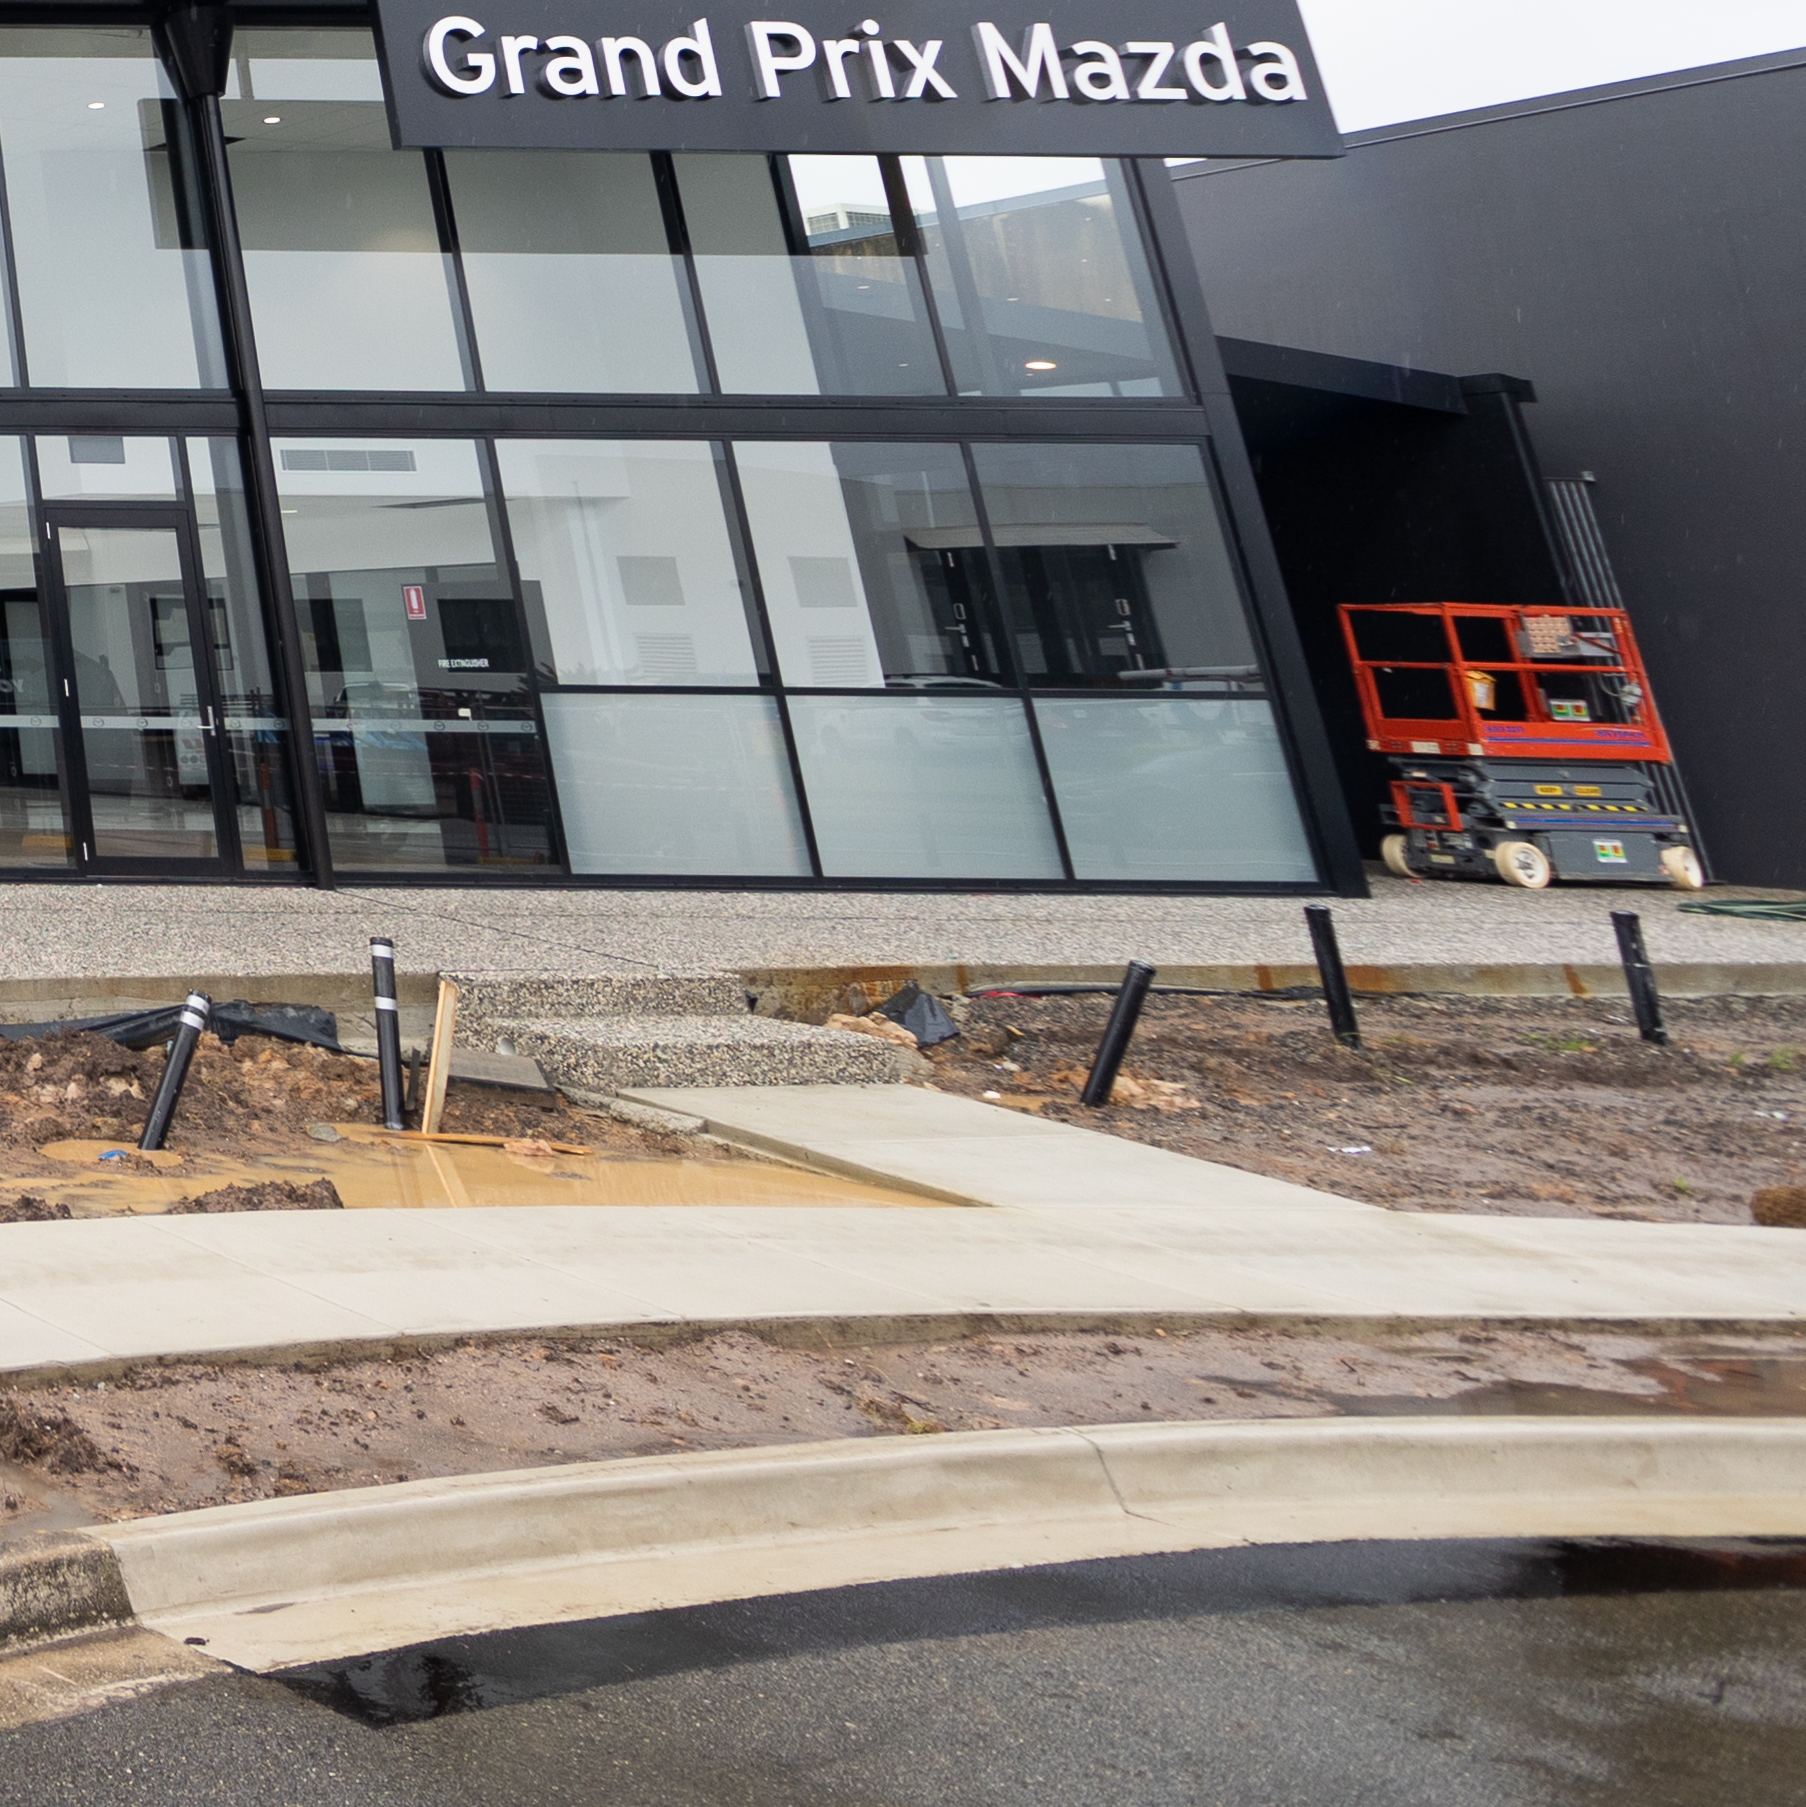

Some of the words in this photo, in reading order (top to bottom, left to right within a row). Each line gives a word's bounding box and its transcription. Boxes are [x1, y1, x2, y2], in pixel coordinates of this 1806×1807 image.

[423, 14, 723, 100] Grand
[743, 18, 958, 102] Prix
[974, 21, 1309, 103] Mazda
